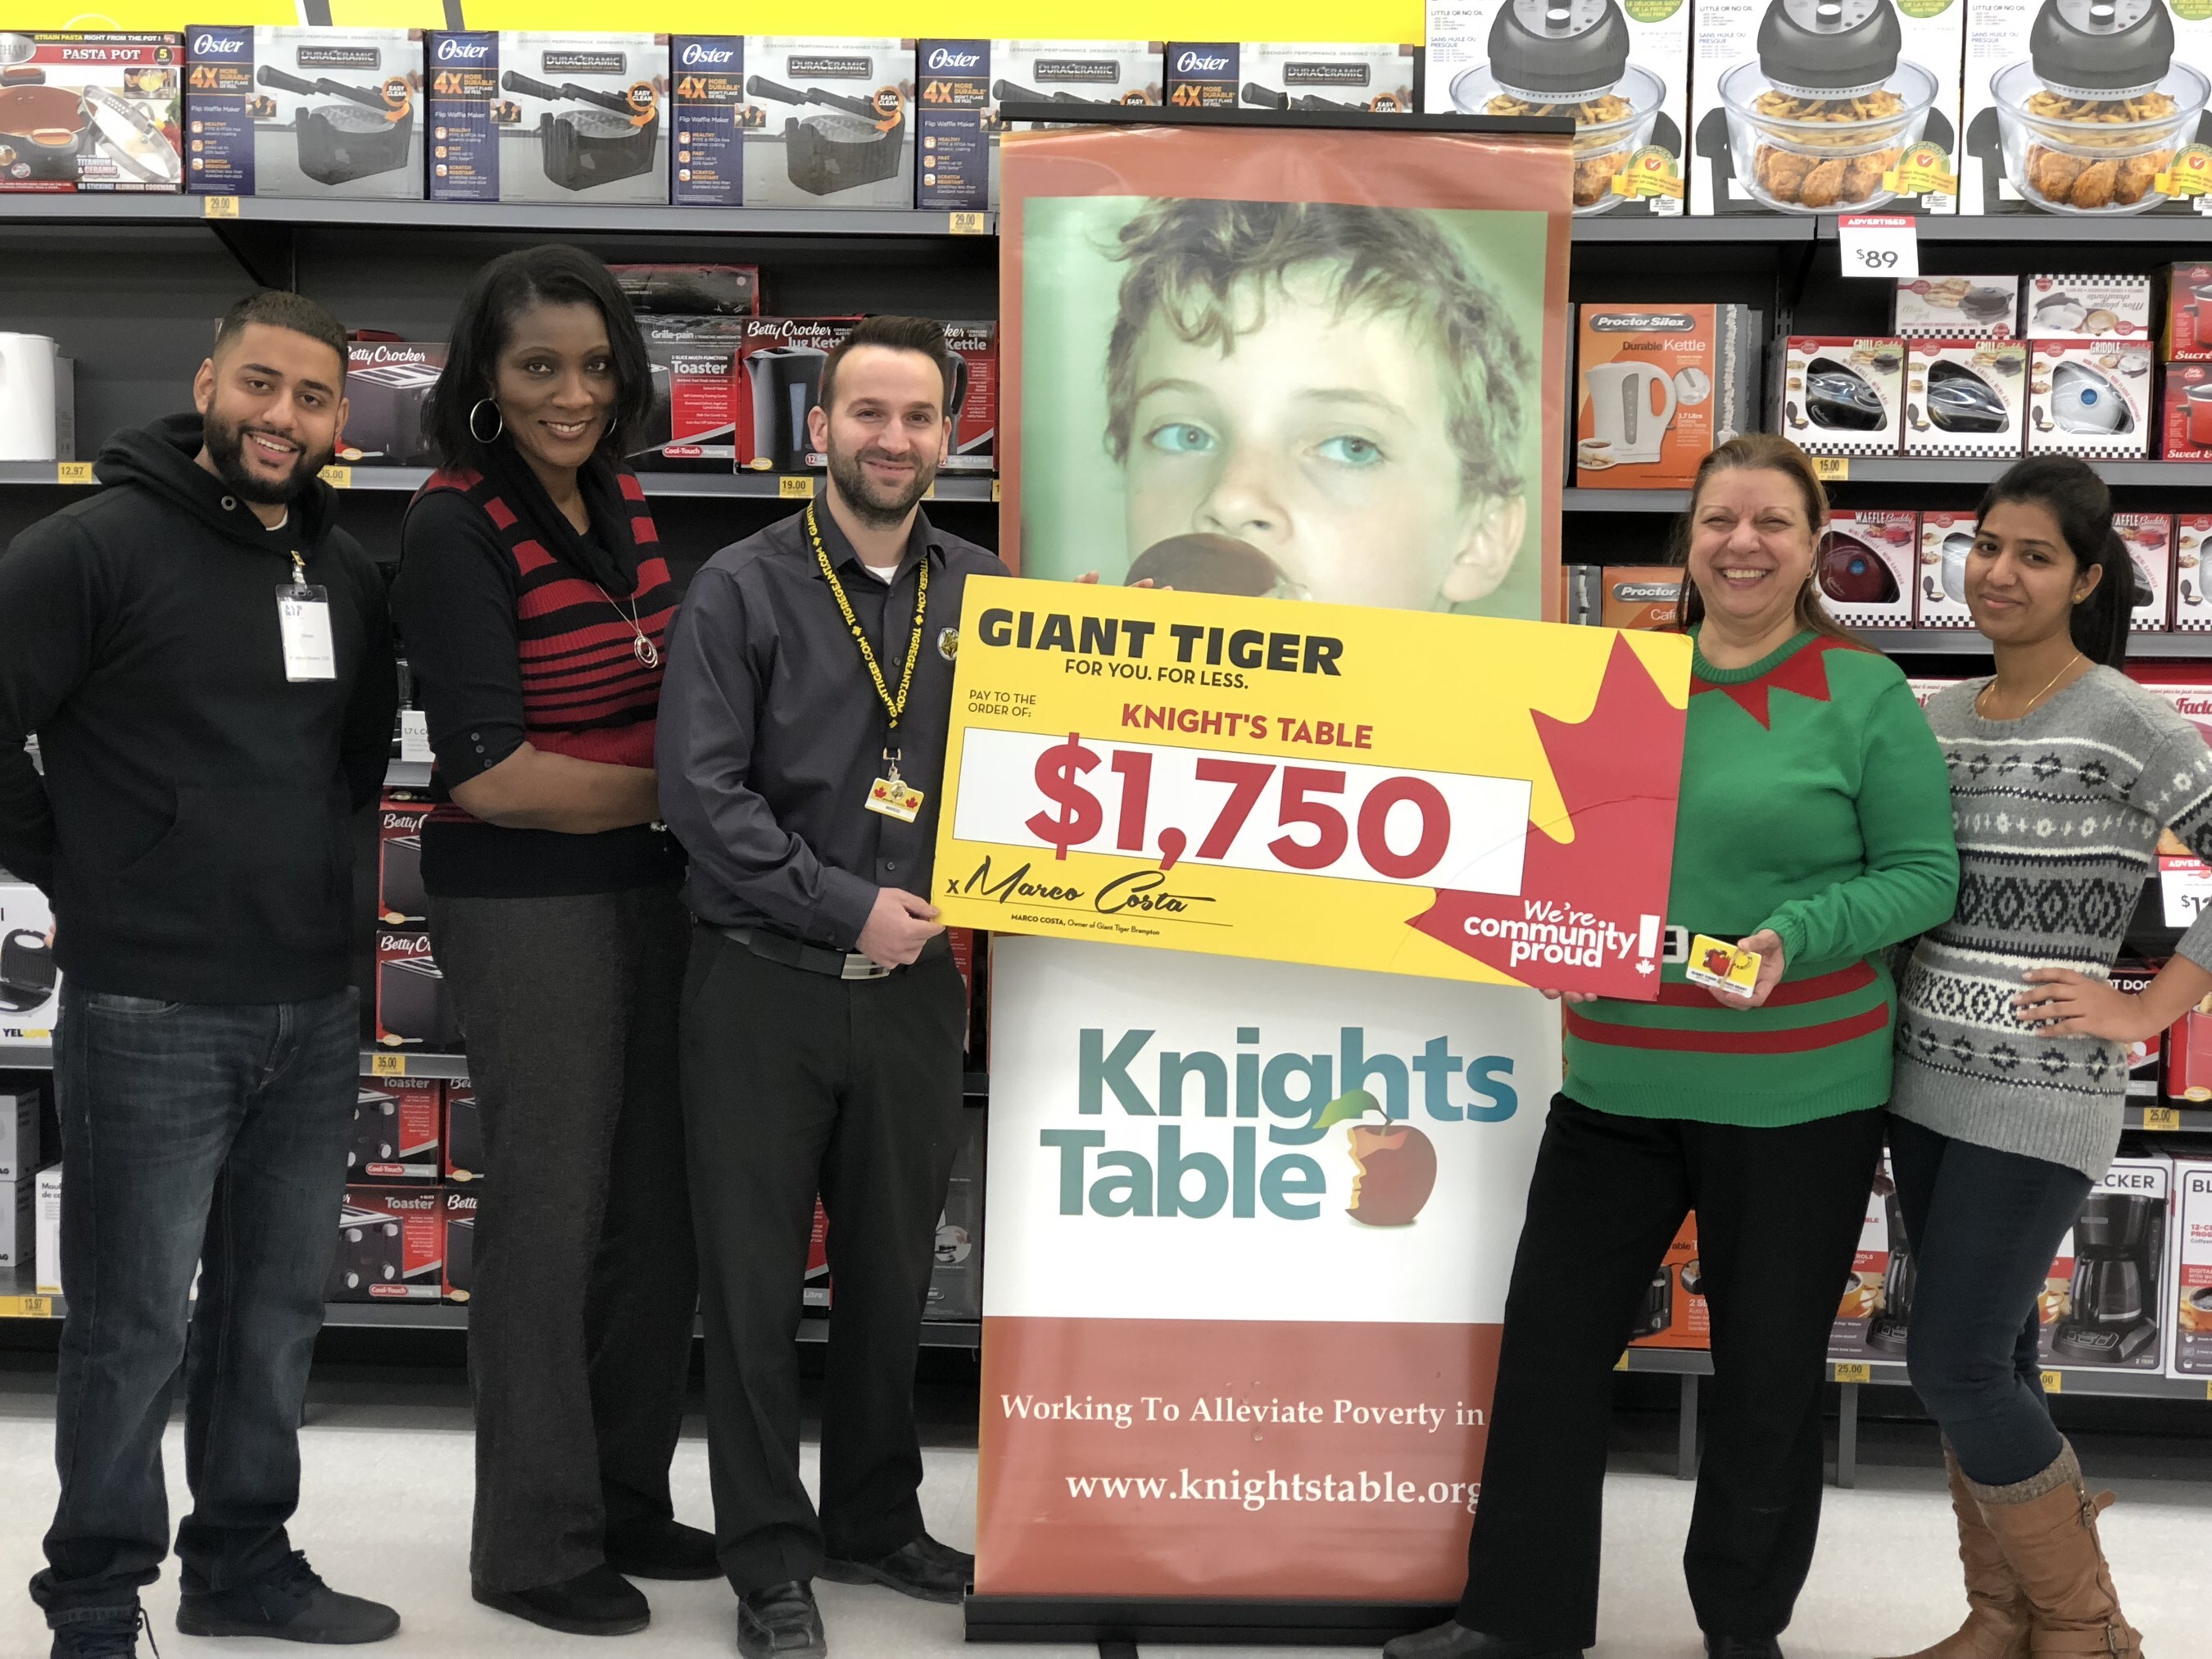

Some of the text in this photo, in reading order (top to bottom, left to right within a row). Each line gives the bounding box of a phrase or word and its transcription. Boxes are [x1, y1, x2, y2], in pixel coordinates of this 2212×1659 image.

[193, 34, 244, 55] Oster
[437, 39, 488, 60] Oster
[62, 49, 140, 60] PASTA POT
[159, 49, 167, 58] 5
[301, 49, 374, 61] DURACERAMIC
[546, 54, 620, 66] DURACERAMIC
[682, 43, 733, 65] Oster
[928, 48, 980, 69] Oster
[791, 59, 866, 70] DURACERAMIC
[1177, 51, 1229, 72] Oster
[1038, 63, 1113, 75] DURACERAMIC
[1288, 66, 1363, 78] DURACERAMIC
[189, 65, 220, 88] 4X
[433, 70, 463, 93] 4X
[678, 76, 708, 98] 4X
[923, 80, 953, 103] 4X
[1172, 84, 1202, 107] 4X
[211, 197, 230, 209] 29.00
[955, 214, 975, 226] 29.00
[1848, 218, 1906, 226] ADVERTISED
[1856, 248, 1898, 270] $89
[1598, 316, 1685, 327] Proctor Silex
[651, 330, 694, 341] Grille-pain
[747, 320, 831, 340] Betty Crocker
[945, 338, 987, 351] Kettle
[1622, 339, 1706, 351] Durable Kettle
[1853, 339, 1874, 351] GRILL
[1975, 341, 1996, 353] GRILL
[2090, 342, 2121, 355] GRIDDLE
[374, 345, 426, 363] Crocker
[671, 360, 728, 374] Toaster
[664, 447, 728, 456] Cool-Touch Housing
[2168, 450, 2201, 459] Sweet
[808, 456, 816, 464] 12
[1820, 460, 1840, 471] 15.00
[61, 466, 84, 475] 12.97
[320, 469, 343, 479] 35.00
[782, 480, 806, 490] 19.00
[1856, 512, 1913, 524] WAFFLE Buddy
[2139, 515, 2167, 525] Buddy
[814, 546, 857, 627] TIGREGEANT.COM
[1621, 587, 1677, 596] Proctor
[977, 607, 1345, 677] GIANT TIGER
[857, 636, 899, 718] GIANTTIGER.COM
[895, 628, 921, 714] TIGREGEANT.COM
[1064, 660, 1249, 690] FOR YOU. FOR LESS.
[968, 690, 1037, 705] PAY TO THE
[968, 703, 1032, 718] ORDER OF:
[1120, 703, 1374, 750] KNIGHT'S TABLE
[1024, 732, 1451, 880] $1,750
[383, 814, 416, 831] Betty
[964, 854, 1085, 904] Marco
[1094, 870, 1217, 915] Costa
[1524, 899, 1597, 927] We're
[1011, 913, 1160, 936] MARCO COSTA, Owner of Giant Tiger Brampton
[1463, 915, 1637, 960] community
[380, 936, 415, 954] Betty
[1509, 941, 1602, 968] proud
[377, 1057, 397, 1068] 35.00
[382, 1077, 430, 1089] Toaster
[1078, 1027, 1519, 1145] Knights
[2150, 1109, 2171, 1122] 25.00
[368, 1165, 402, 1174] Cool-Touch
[1040, 1124, 1327, 1221] Table
[385, 1197, 434, 1210] Toaster
[370, 1286, 407, 1296] Cool-Touch
[25, 1299, 43, 1311] 13.97
[1837, 1364, 1862, 1374] 25.00
[1000, 1394, 1485, 1433] Working To Alleviate Poverty in
[1065, 1469, 1482, 1514] www.knightstable.org
